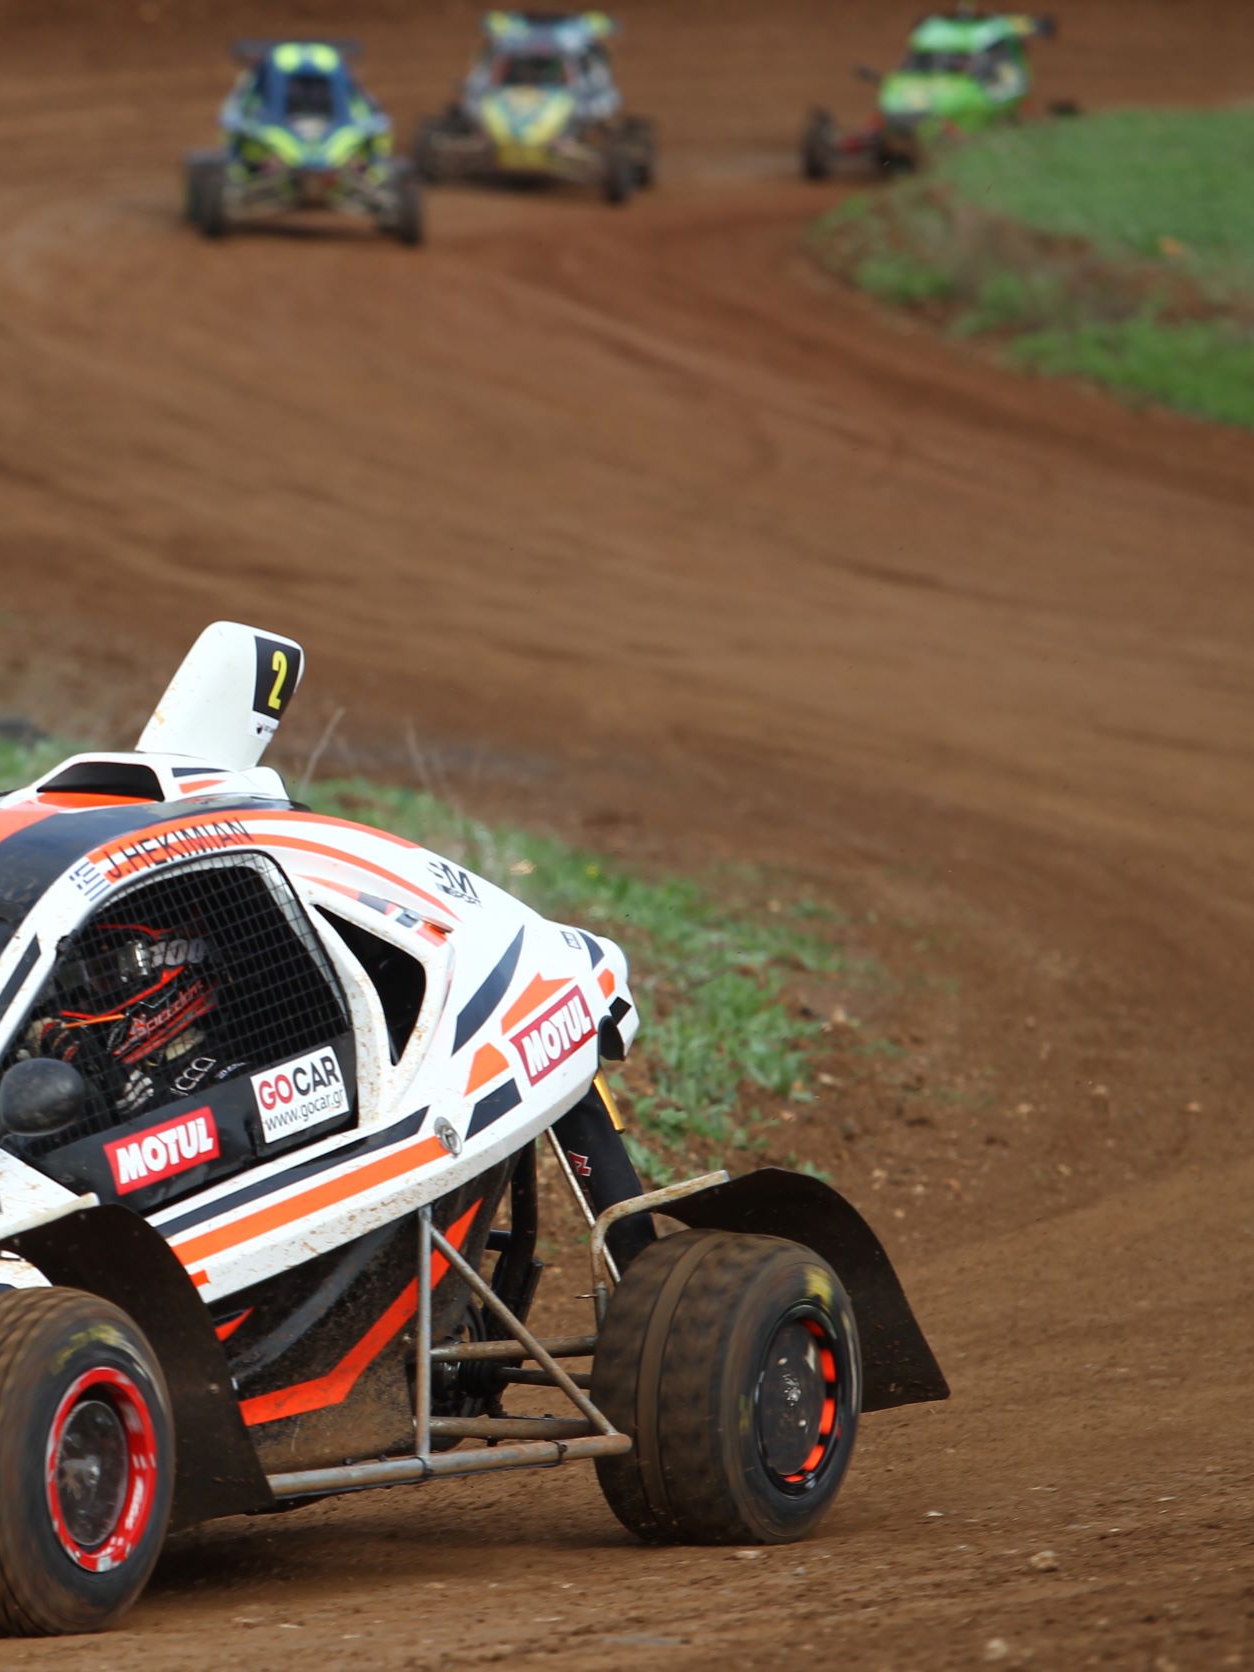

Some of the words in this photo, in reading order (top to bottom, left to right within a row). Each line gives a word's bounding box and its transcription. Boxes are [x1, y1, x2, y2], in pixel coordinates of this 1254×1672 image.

[268, 650, 288, 710] 2
[103, 816, 255, 879] J.HEKIMIAN
[521, 995, 592, 1078] MOTUL
[259, 1055, 340, 1111] GOCAR
[265, 1089, 344, 1131] www.gocar.gr
[116, 1116, 214, 1185] MOTUL
